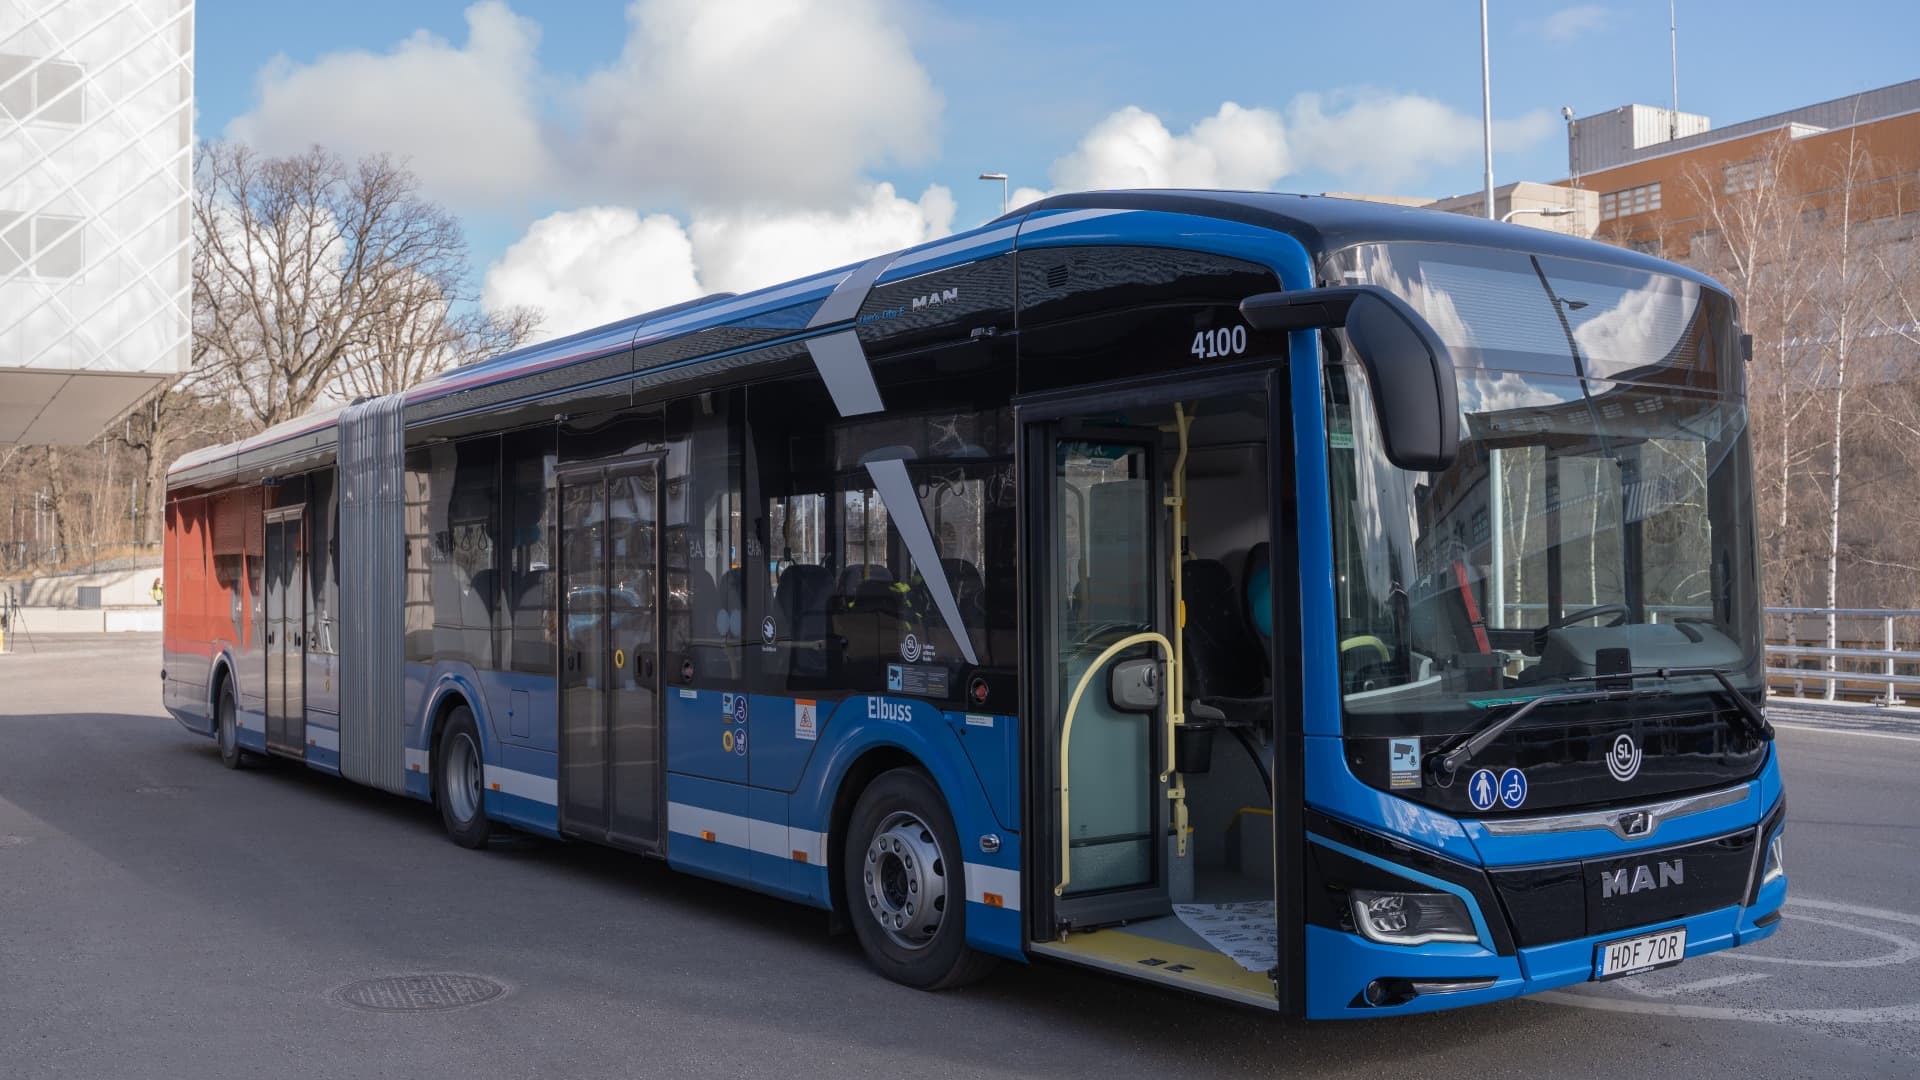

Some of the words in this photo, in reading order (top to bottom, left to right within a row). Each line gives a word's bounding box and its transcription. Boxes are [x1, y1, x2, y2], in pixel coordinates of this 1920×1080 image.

[912, 287, 958, 313] MAN
[1191, 324, 1247, 359] 4100
[907, 639, 915, 648] SL
[867, 696, 912, 722] Elbuss
[1617, 743, 1631, 759] SL
[1601, 859, 1684, 899] MAN
[1610, 942, 1642, 971] HDF
